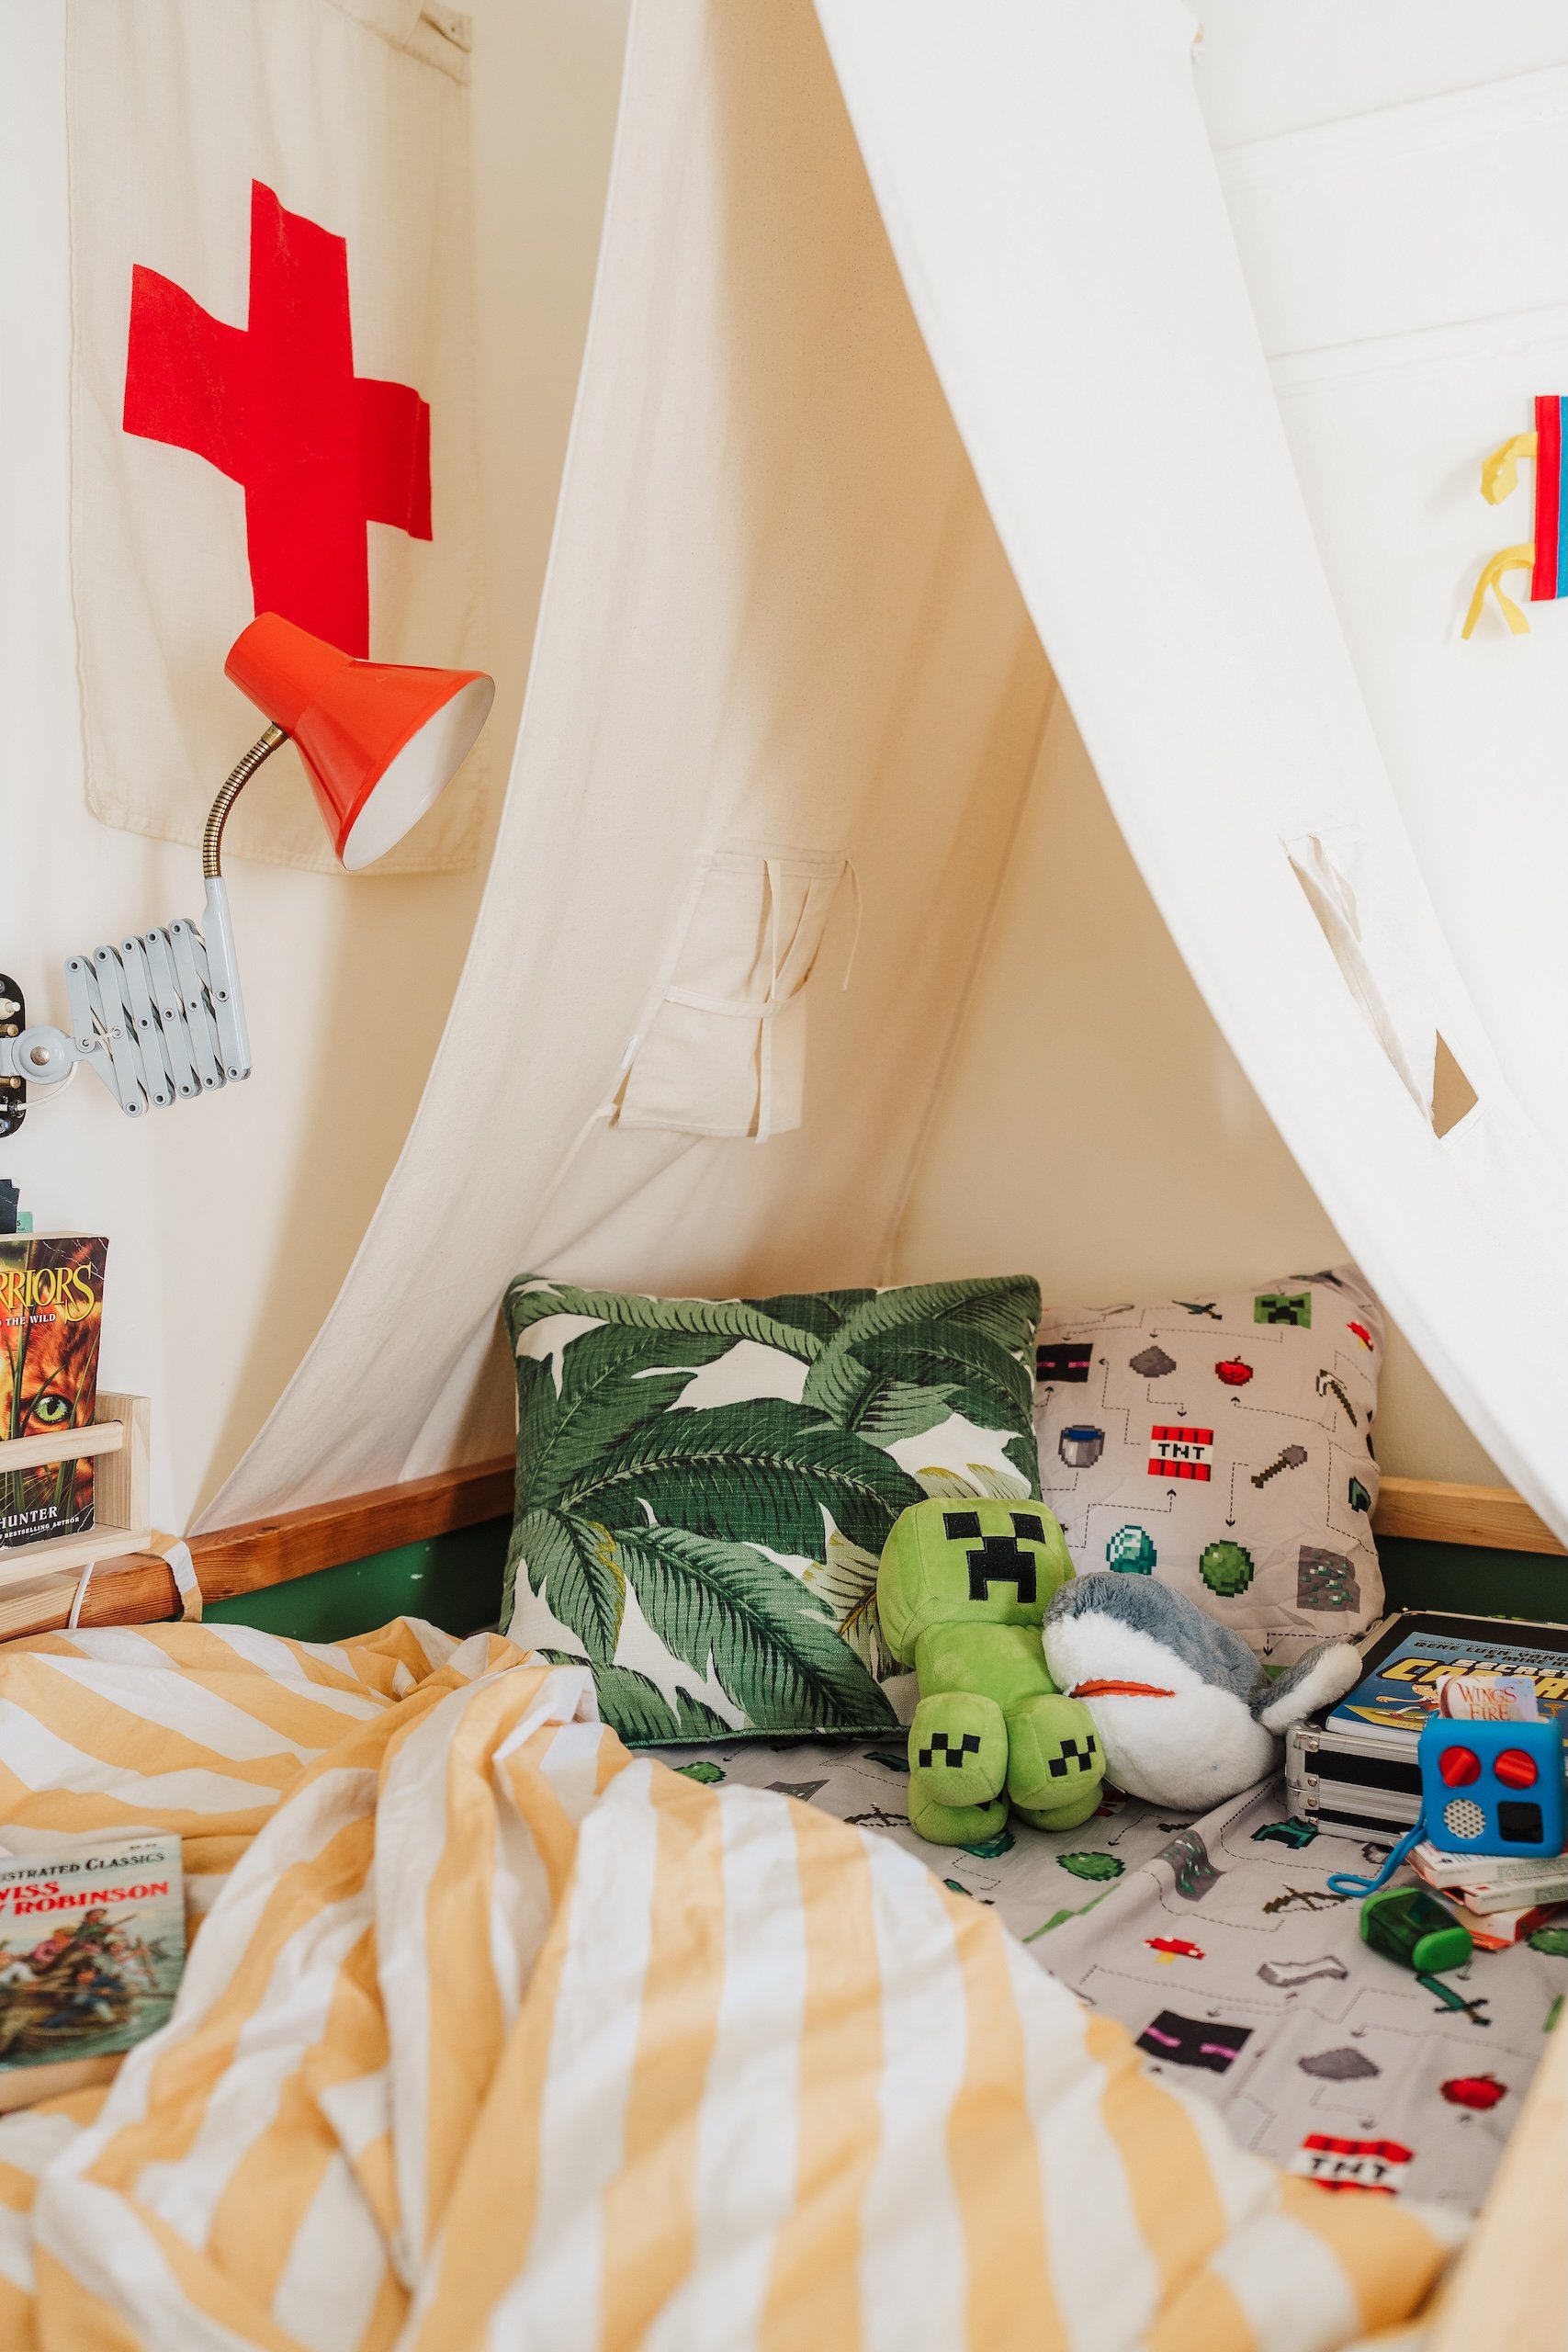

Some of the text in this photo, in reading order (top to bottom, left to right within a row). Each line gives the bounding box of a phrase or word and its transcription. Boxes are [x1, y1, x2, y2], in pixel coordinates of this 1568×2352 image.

[6, 1317, 26, 1326] THE
[29, 1314, 56, 1324] WILD
[1158, 1443, 1205, 1460] TNT
[0, 1507, 58, 1530] HUNTER
[5, 1523, 50, 1539] BESTSELLING
[52, 1517, 80, 1528] AUTHOR
[1414, 1642, 1461, 1651] GENE
[1456, 1682, 1517, 1705] WINGS
[1470, 1704, 1511, 1721] FIRE
[14, 1882, 169, 1916] ROBINSON
[1312, 2157, 1388, 2181] TNT
